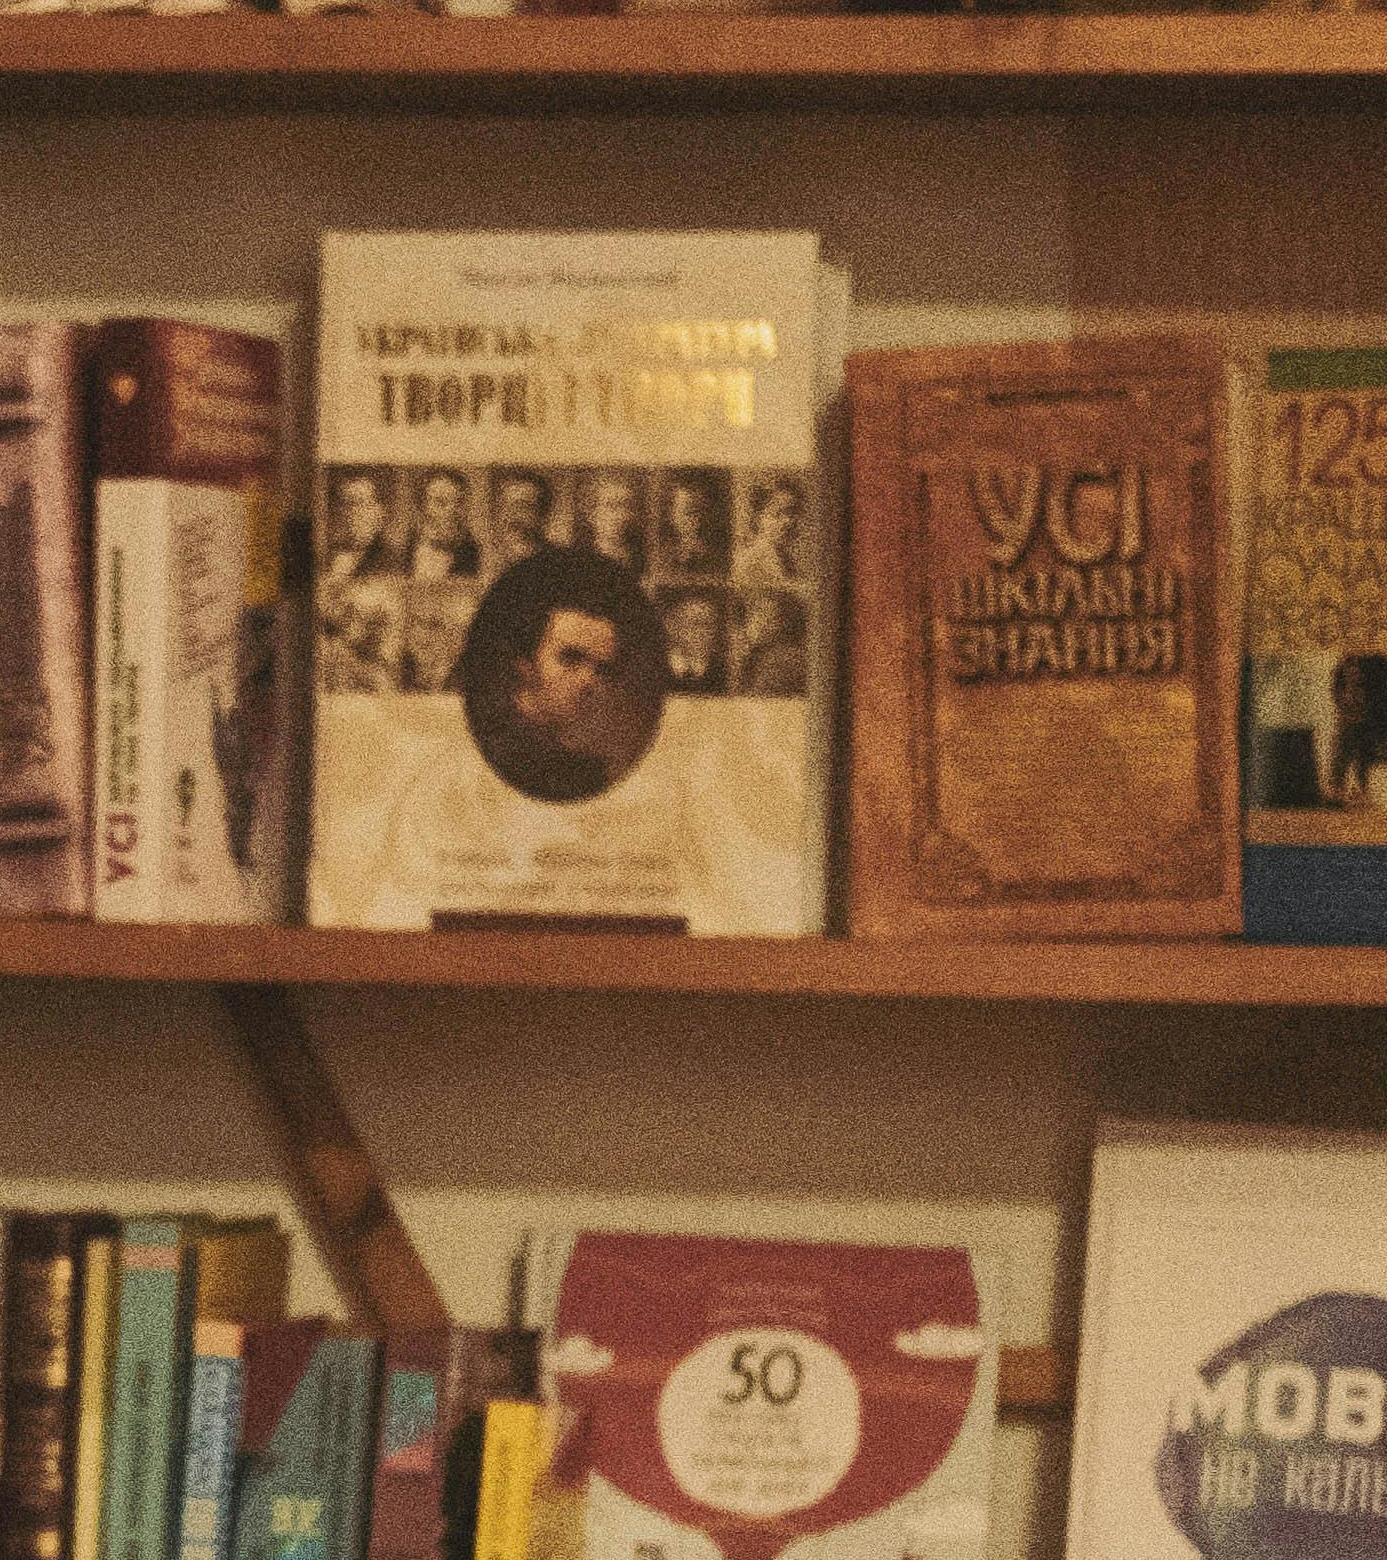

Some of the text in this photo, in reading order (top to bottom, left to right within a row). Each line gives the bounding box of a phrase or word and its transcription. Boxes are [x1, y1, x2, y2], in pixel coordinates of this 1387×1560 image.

[970, 462, 1141, 565] УСІ
[953, 620, 1175, 671] ЗНАННЯ
[714, 1339, 806, 1409] 50
